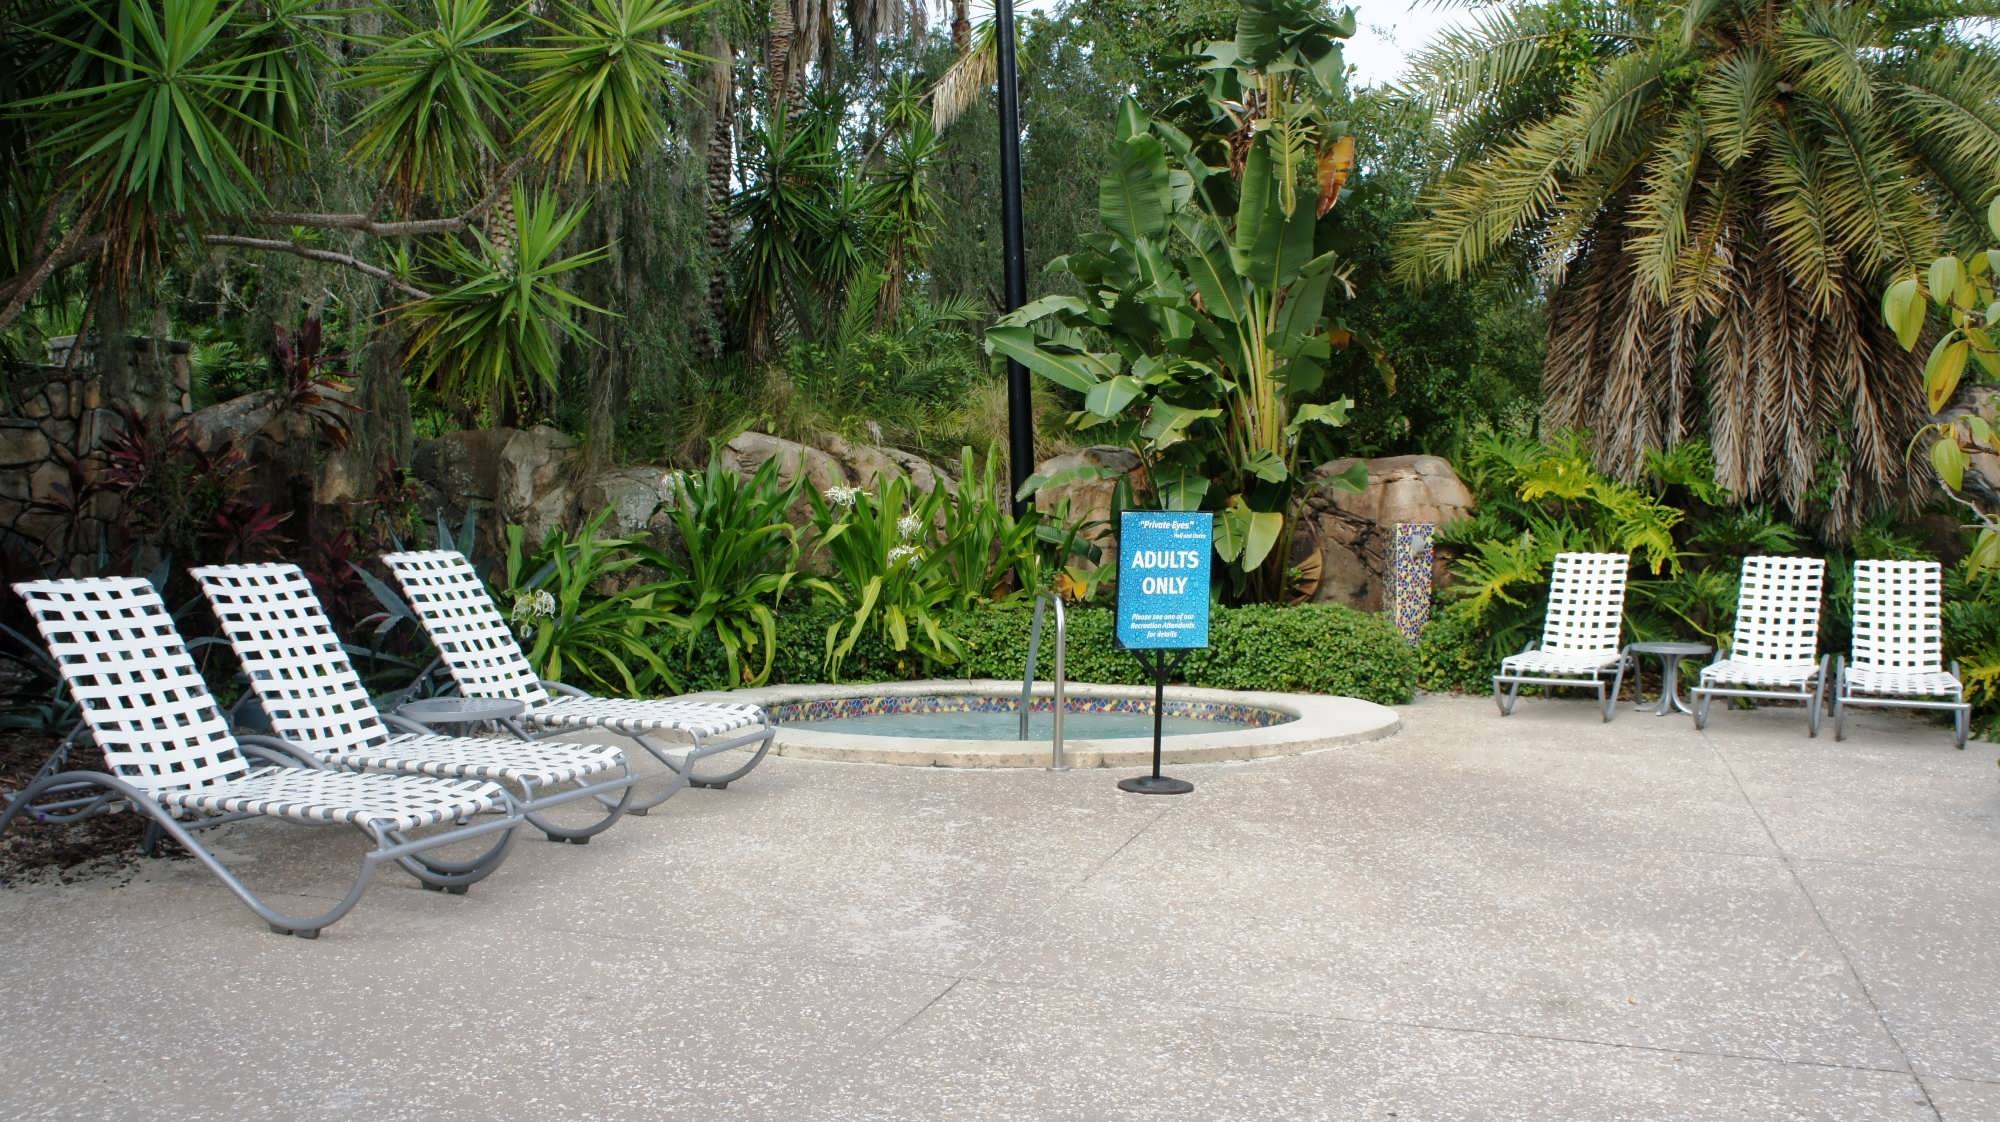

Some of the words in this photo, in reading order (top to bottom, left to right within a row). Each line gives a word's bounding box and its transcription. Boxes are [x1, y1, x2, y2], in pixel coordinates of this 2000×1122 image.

[1140, 520, 1170, 529] "Private
[1171, 520, 1195, 530] Eyes"
[1131, 550, 1200, 569] ADULTS
[1142, 577, 1188, 595] ONLY
[1147, 631, 1156, 639] for
